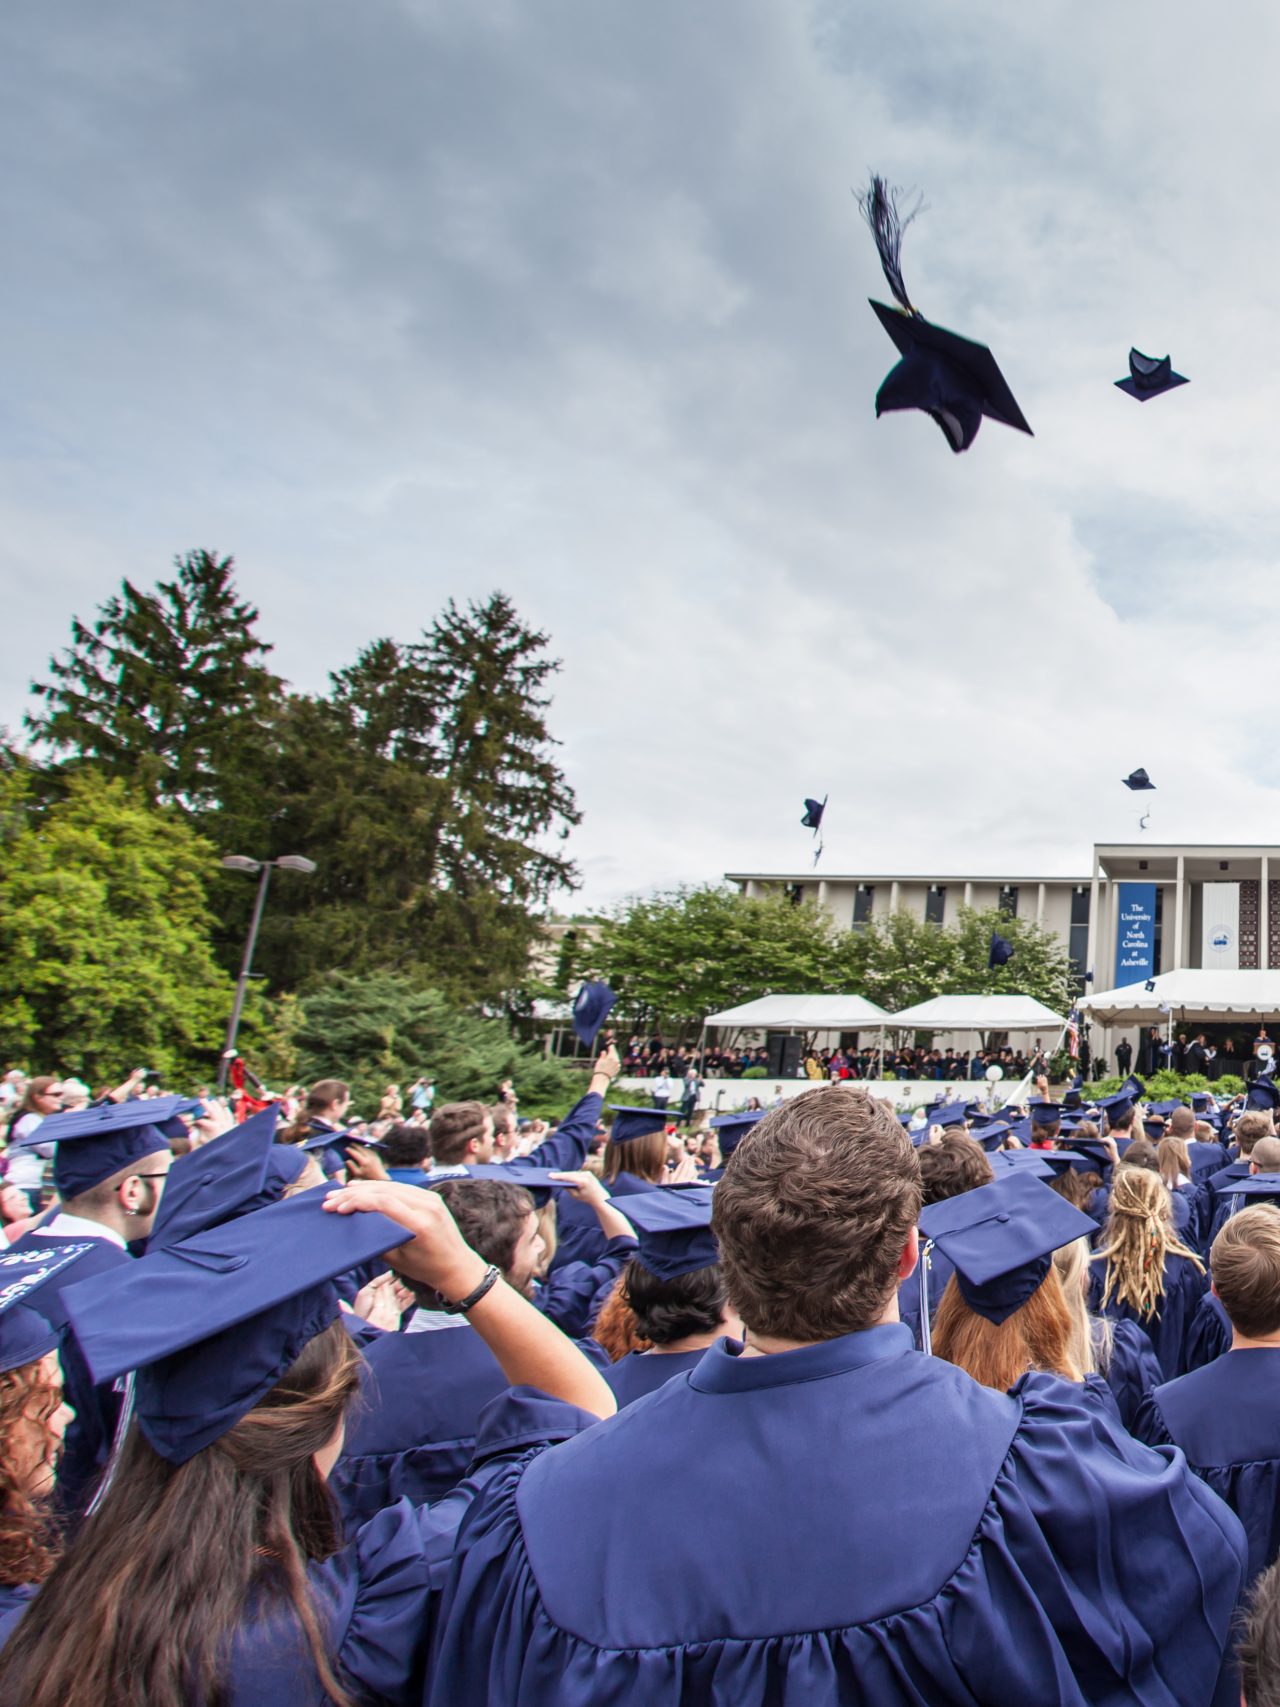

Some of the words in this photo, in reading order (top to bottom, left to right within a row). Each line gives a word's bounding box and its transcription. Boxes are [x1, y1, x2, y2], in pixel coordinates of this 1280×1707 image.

[1131, 904, 1144, 912] The
[1120, 913, 1152, 922] University
[1131, 921, 1140, 930] of
[1126, 931, 1145, 939] North
[1122, 940, 1149, 948] Carolina
[1120, 958, 1149, 967] Asheville
